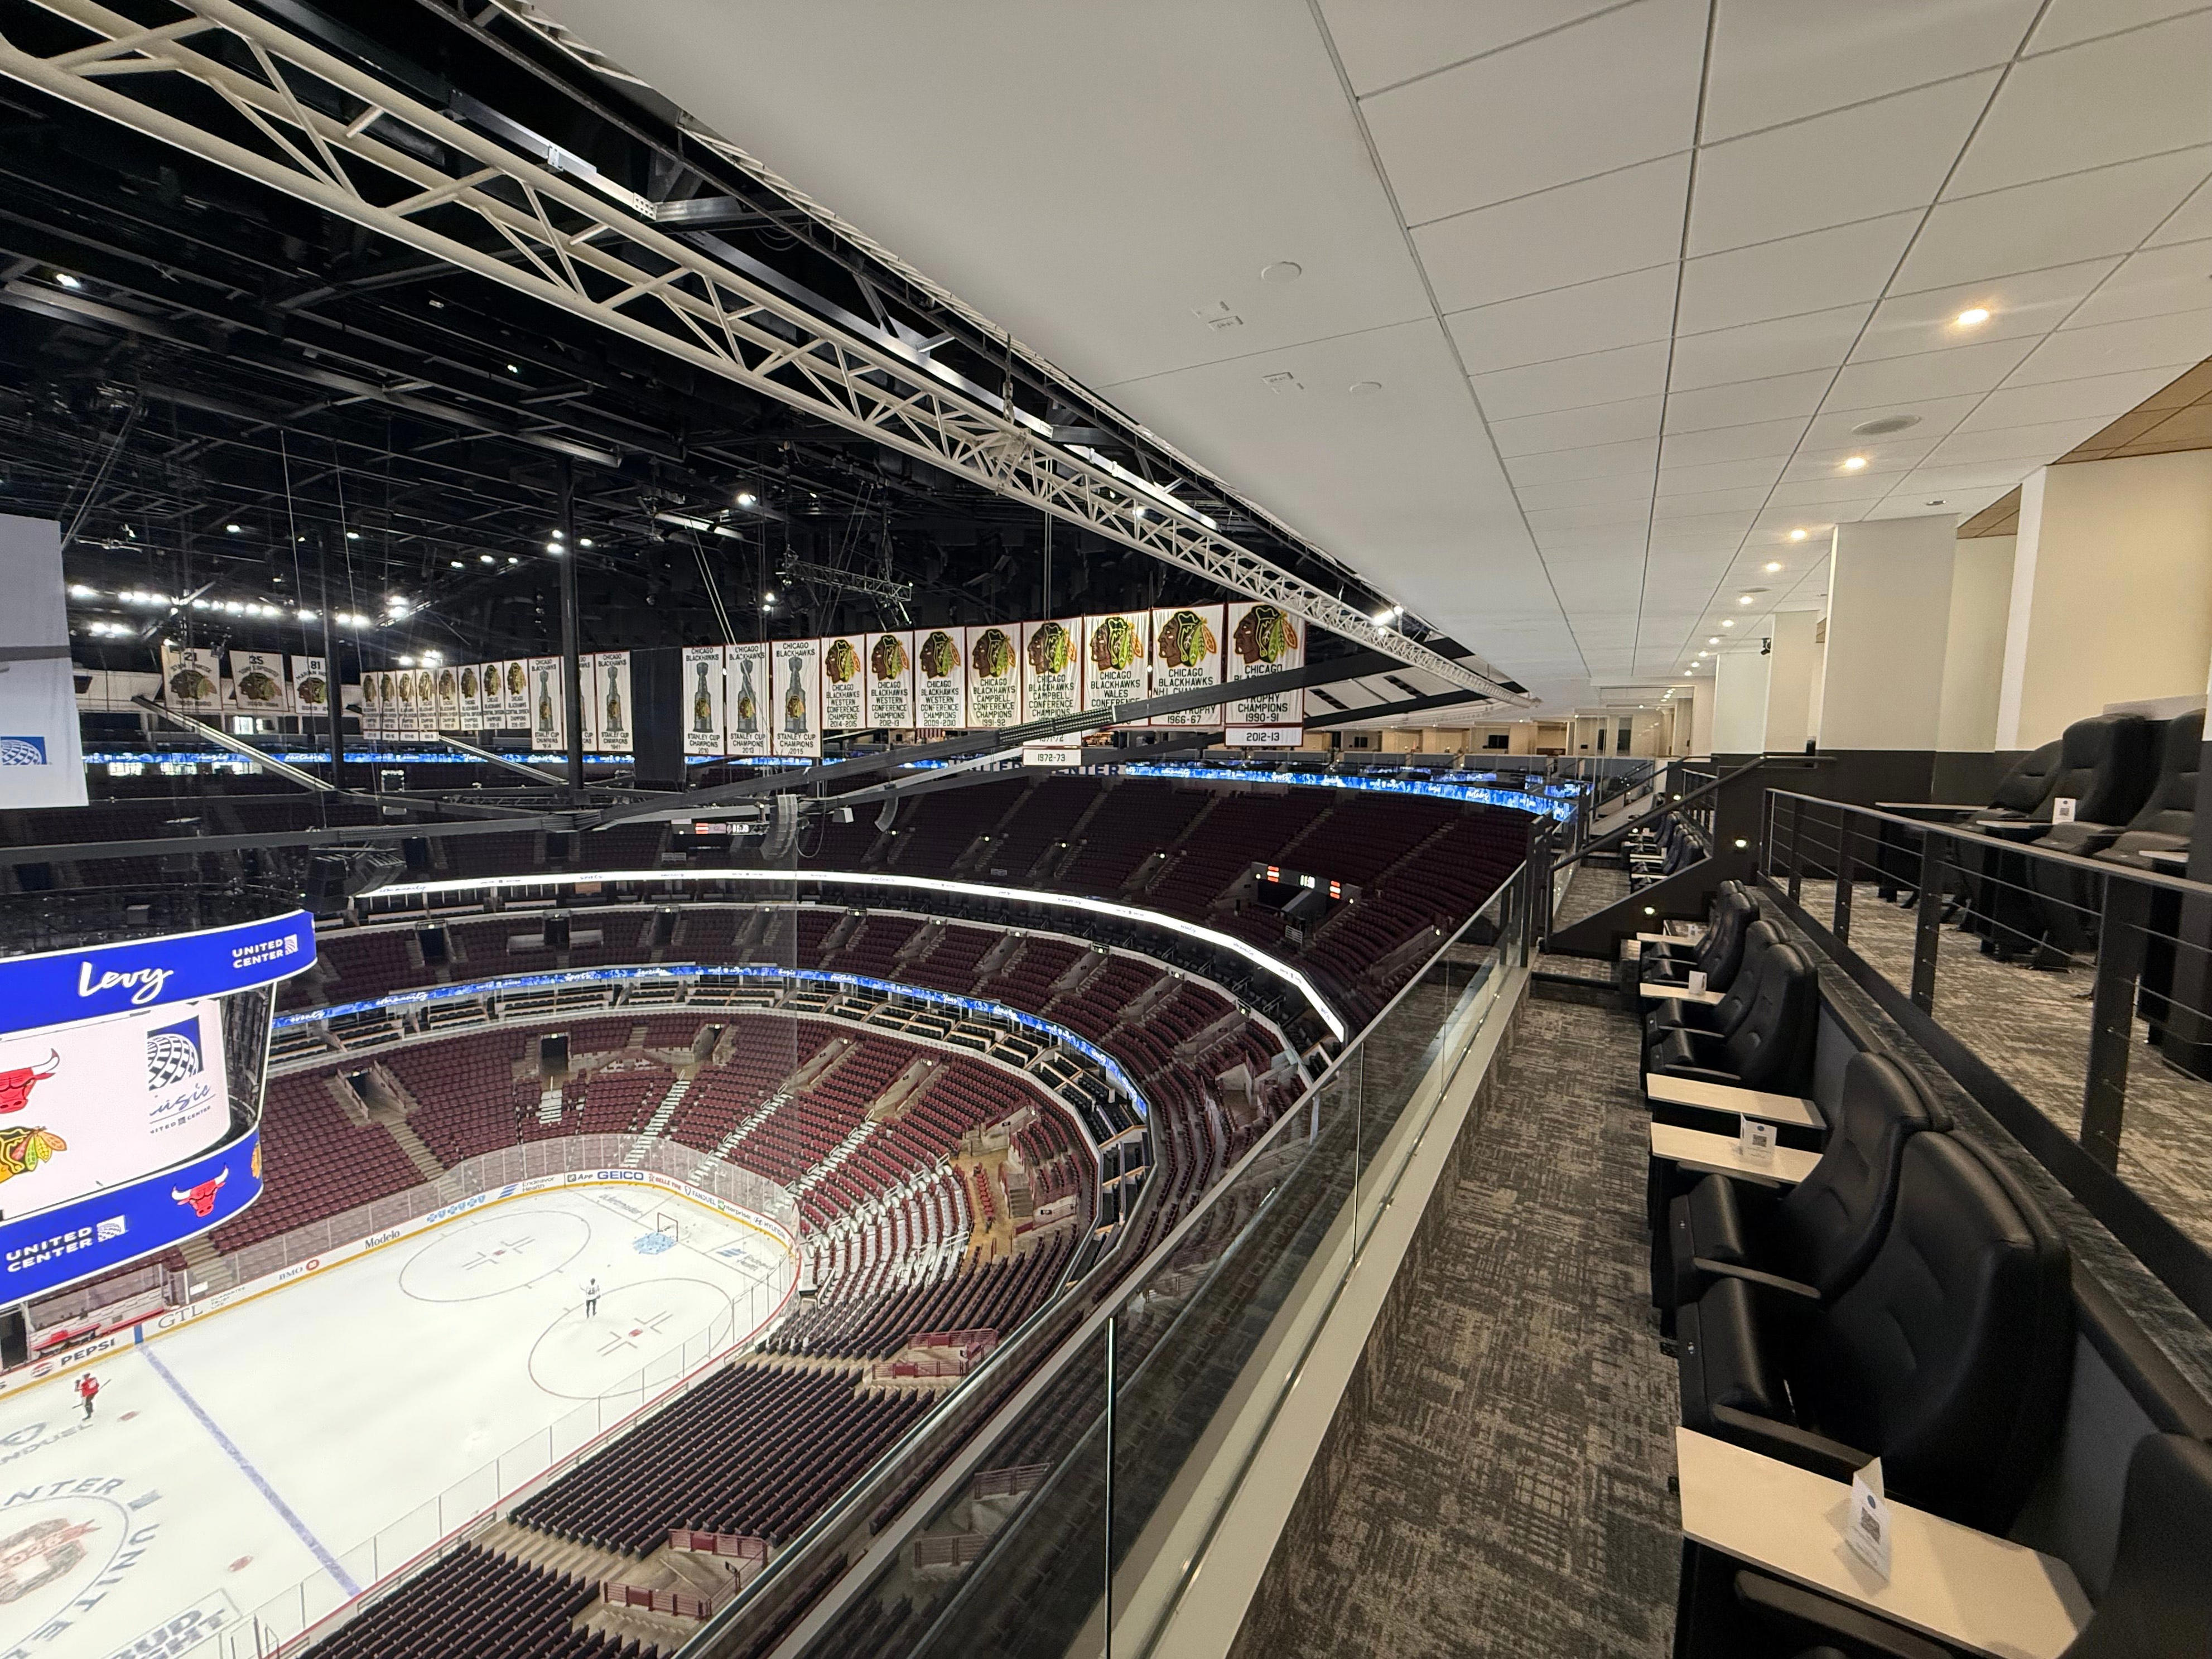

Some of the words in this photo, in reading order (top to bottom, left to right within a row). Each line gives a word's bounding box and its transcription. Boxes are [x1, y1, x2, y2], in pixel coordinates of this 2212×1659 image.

[775, 649, 816, 657] BLACKHAWKS
[249, 655, 263, 664] 35
[311, 660, 320, 669] 81
[1245, 664, 1283, 674] CHICAGO
[1100, 671, 1131, 679] CHICAGO
[1168, 668, 1203, 677] CHICAGO
[980, 678, 1008, 687] CHICAGO
[1037, 674, 1066, 683] CHICAGO
[1158, 677, 1213, 687] BLACKHAWKS
[927, 680, 951, 688] CHICAGO
[1029, 682, 1074, 692] BLACKHAWKS
[1091, 679, 1140, 689] BLACKHAWKS
[921, 687, 959, 696] BLACKHAWKS
[973, 686, 1016, 695] BLACKHAWKS
[1103, 689, 1129, 698] WALES
[977, 695, 1011, 703] CAMPBELL
[1033, 691, 1070, 700] CAMPBELL
[973, 702, 1015, 711] CONFERENCE
[1029, 700, 1073, 708] CONFERENCE
[1238, 703, 1288, 712] CHAMPIONS
[976, 710, 1012, 718] CHAMPIONS
[1032, 708, 1071, 717] CHAMPIONS
[1167, 715, 1202, 724] 1966-67
[1245, 713, 1279, 722] 1990-91
[1246, 732, 1280, 741] 2012-13
[1038, 753, 1066, 762] 1972-73
[232, 939, 283, 958] UNITED
[233, 949, 283, 968] CENTER
[78, 961, 174, 1004] Levy
[597, 1171, 644, 1180] GEICO
[522, 1176, 556, 1187] Endeavor
[523, 1183, 546, 1192] Health
[6, 1227, 93, 1261] UNITED
[365, 1229, 400, 1250] Modelo
[7, 1238, 93, 1272] CENTER
[278, 1266, 303, 1281] BMO
[158, 1304, 203, 1329] GTL
[61, 1338, 115, 1366] PEPSI
